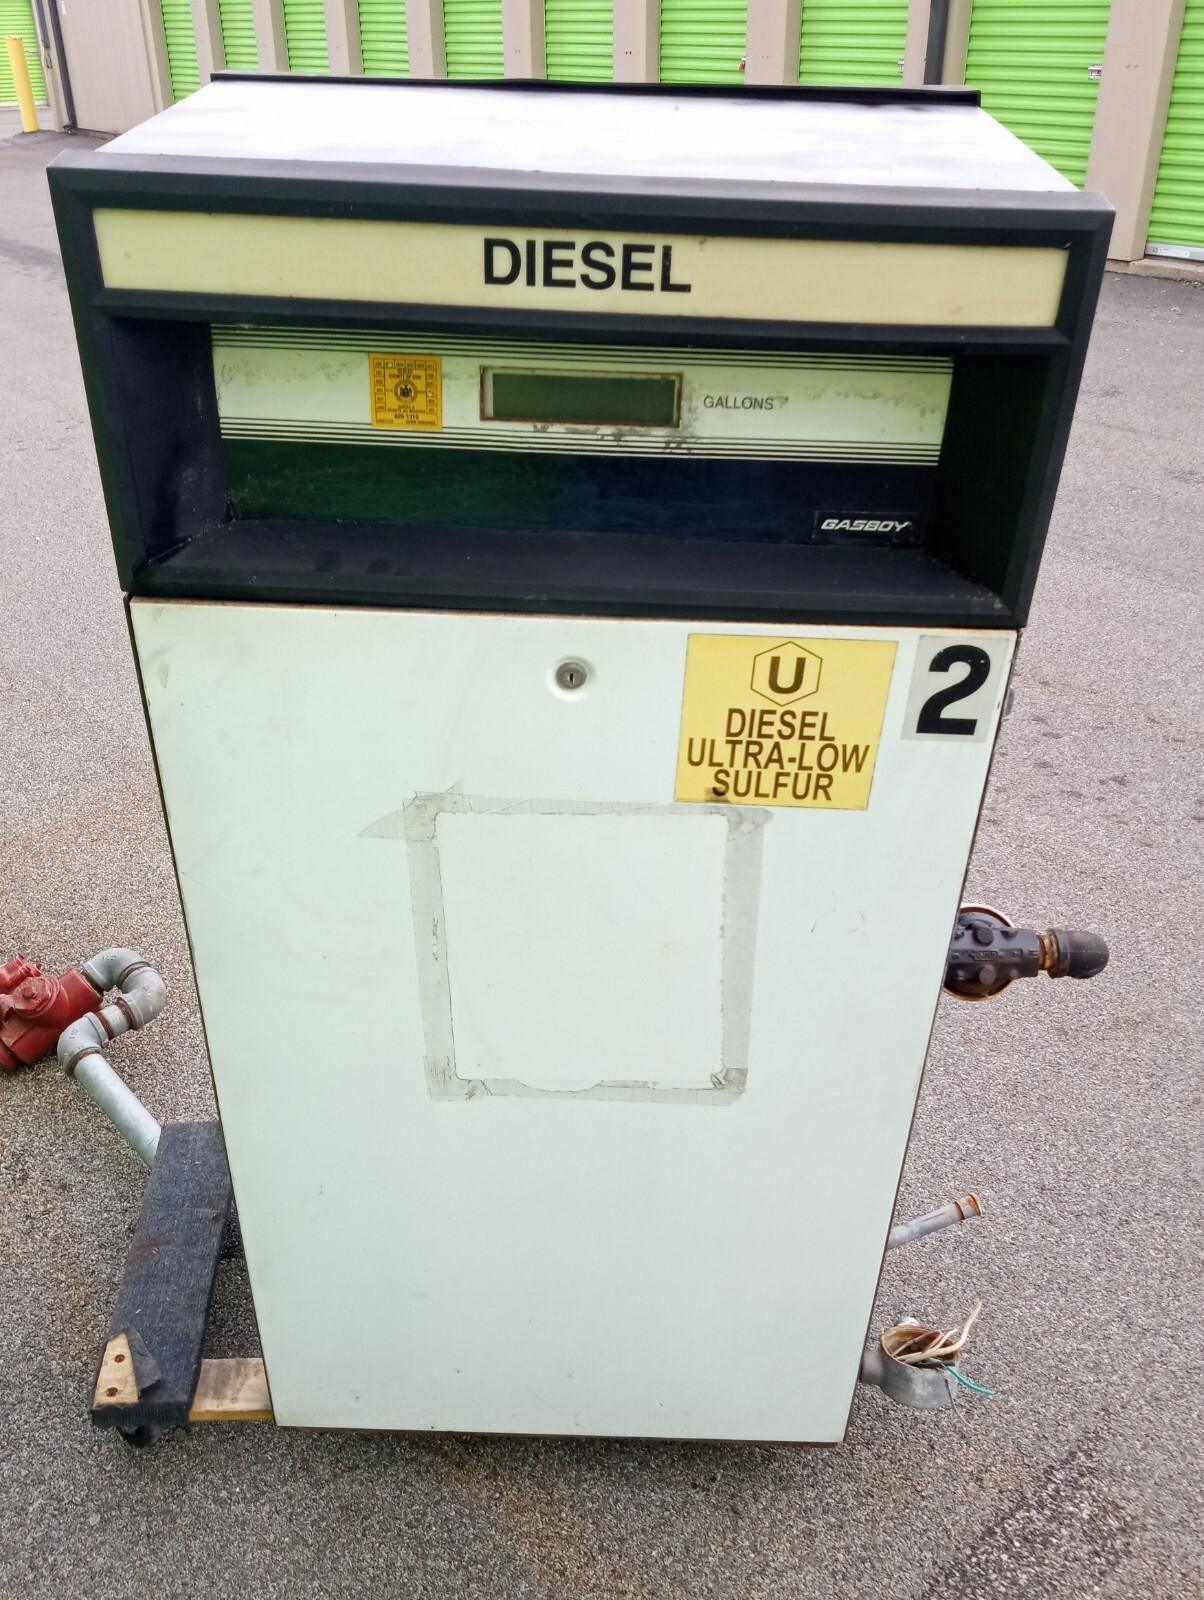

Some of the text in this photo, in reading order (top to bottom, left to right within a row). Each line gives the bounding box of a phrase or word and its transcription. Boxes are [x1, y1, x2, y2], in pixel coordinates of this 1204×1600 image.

[484, 237, 691, 292] DIESEL
[703, 395, 774, 411] GALLONS
[821, 518, 909, 533] GASBOY
[768, 656, 806, 694] U
[916, 644, 991, 735] 2
[725, 707, 836, 742] DIESEL
[687, 737, 870, 773] ULTRA-LOW
[712, 768, 834, 801] SULFUR
